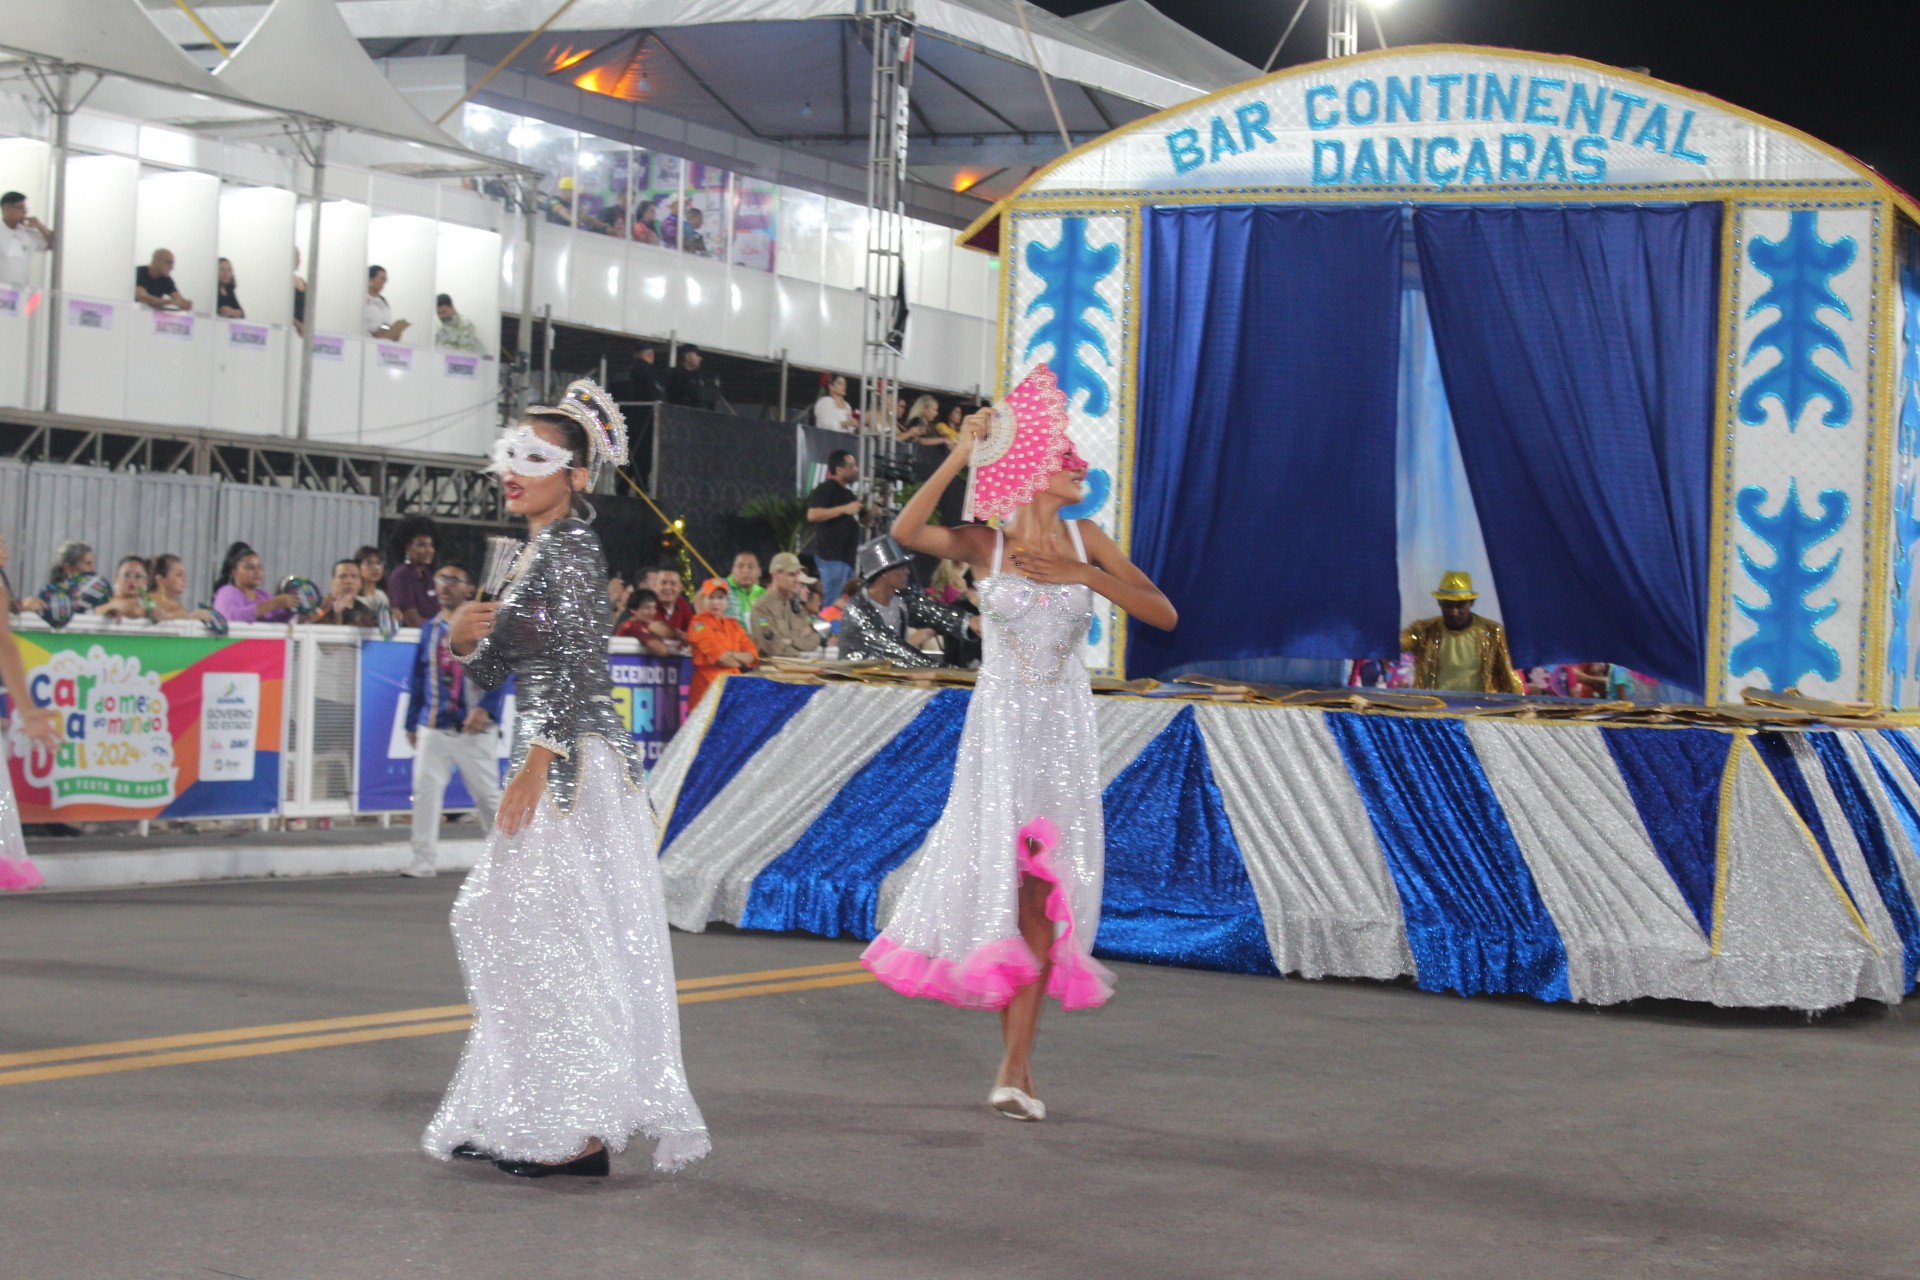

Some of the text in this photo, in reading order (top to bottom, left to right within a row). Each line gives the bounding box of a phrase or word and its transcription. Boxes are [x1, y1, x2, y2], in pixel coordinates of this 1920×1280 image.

[1165, 71, 1708, 176] BAR CONTINENTAL
[1311, 132, 1608, 191] DANÇARAS
[95, 695, 162, 714] do meio
[206, 708, 253, 719] GOVERNO
[107, 716, 162, 735] mundo
[95, 742, 142, 766] 2024
